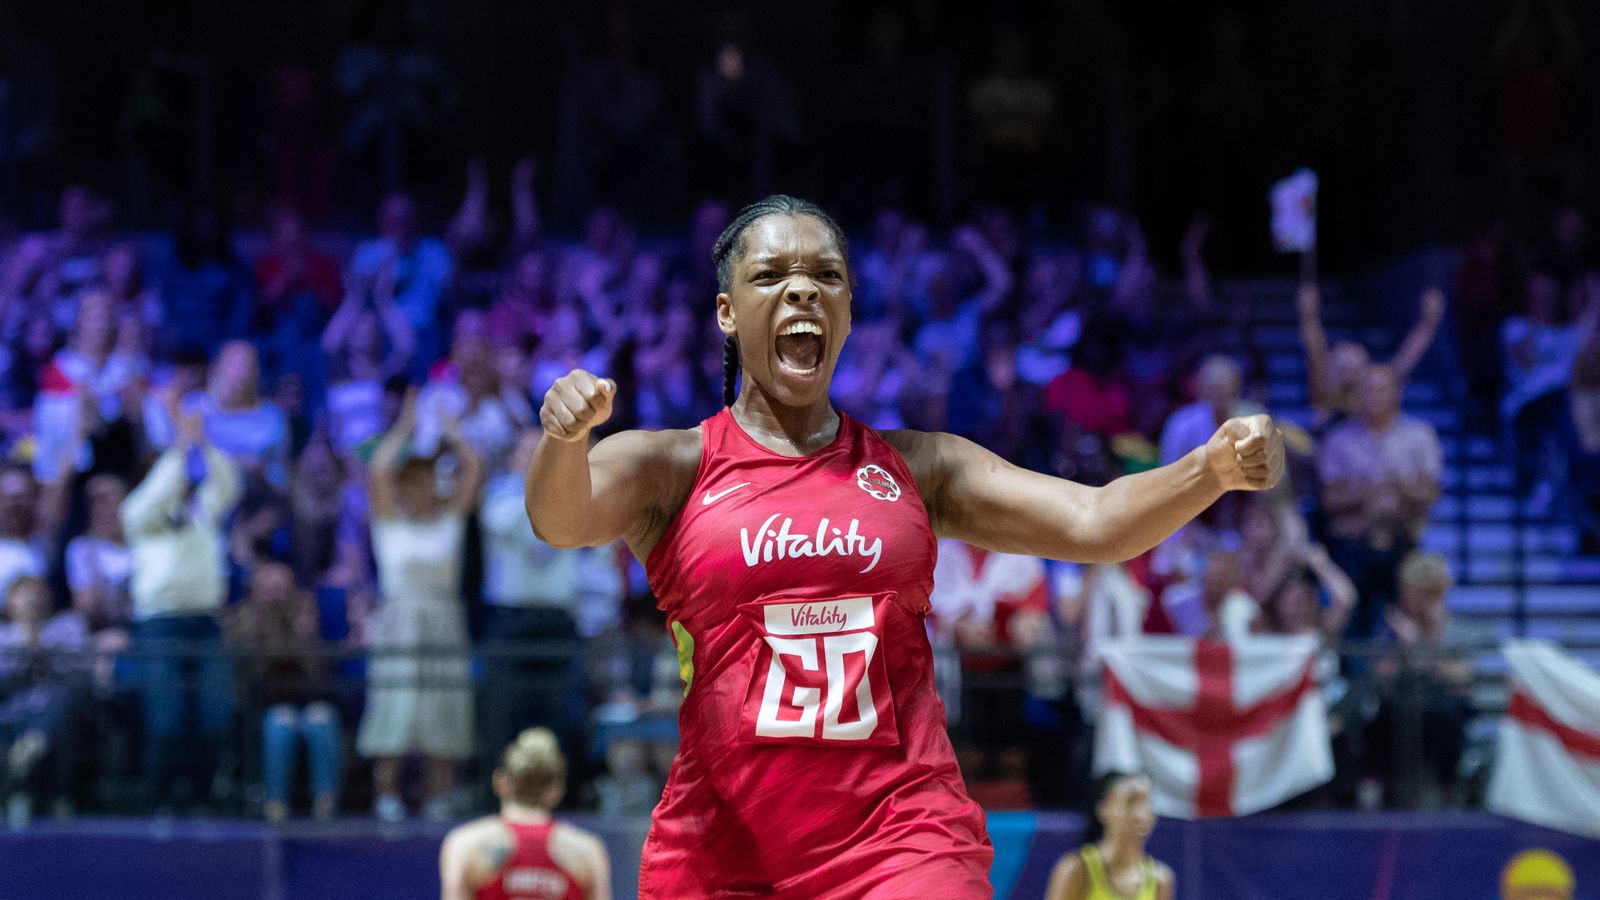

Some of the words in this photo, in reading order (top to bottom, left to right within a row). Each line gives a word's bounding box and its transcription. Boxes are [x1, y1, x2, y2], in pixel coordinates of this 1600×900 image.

[740, 513, 883, 574] Vitality
[790, 603, 847, 631] Vitality
[755, 631, 878, 741] GD
